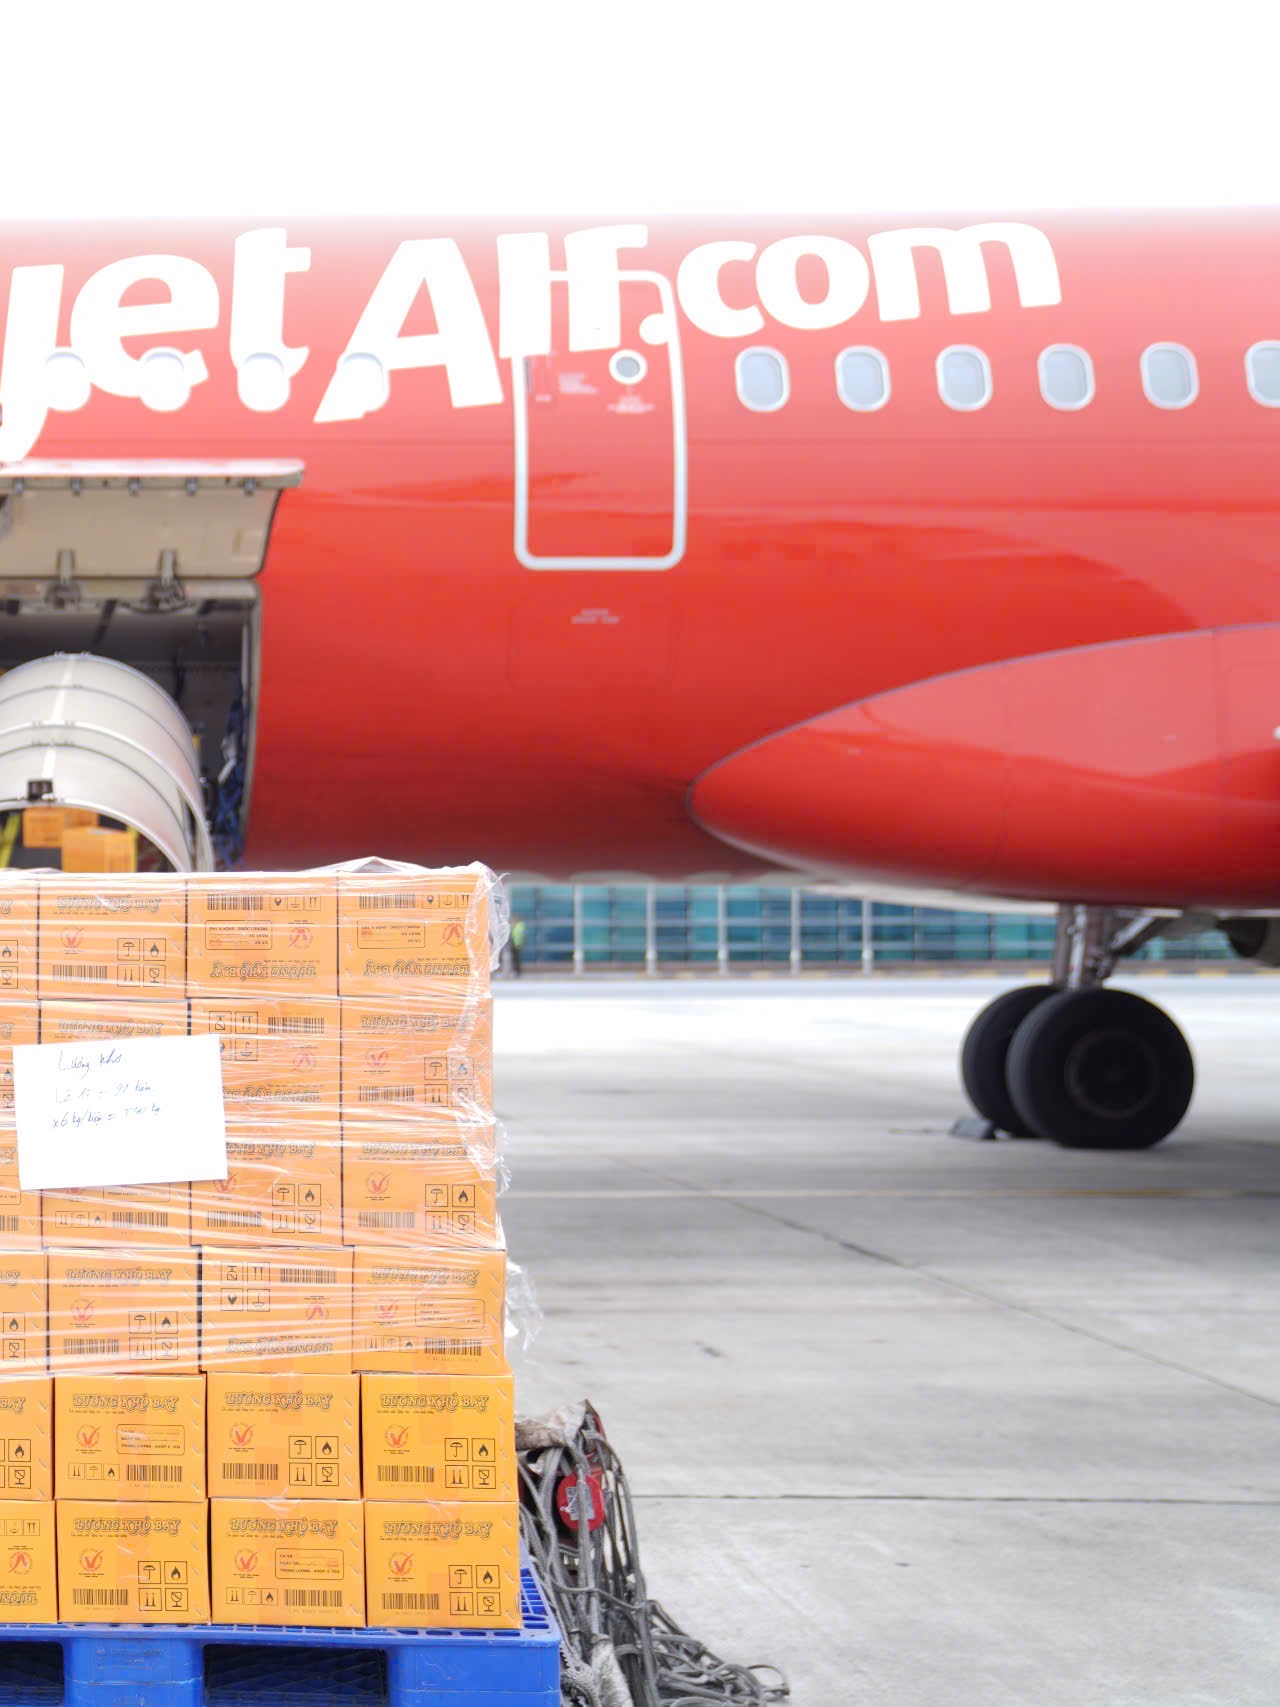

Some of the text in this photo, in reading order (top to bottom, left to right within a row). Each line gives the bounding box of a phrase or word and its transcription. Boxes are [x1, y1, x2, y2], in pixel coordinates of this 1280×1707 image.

[0, 1396, 26, 1415] BAY
[152, 1395, 180, 1414] BAY
[306, 1392, 334, 1411] BAY
[461, 1394, 489, 1413] BAY
[154, 1518, 182, 1536] BAY
[310, 1519, 338, 1538] BAY
[464, 1521, 493, 1540] BAY
